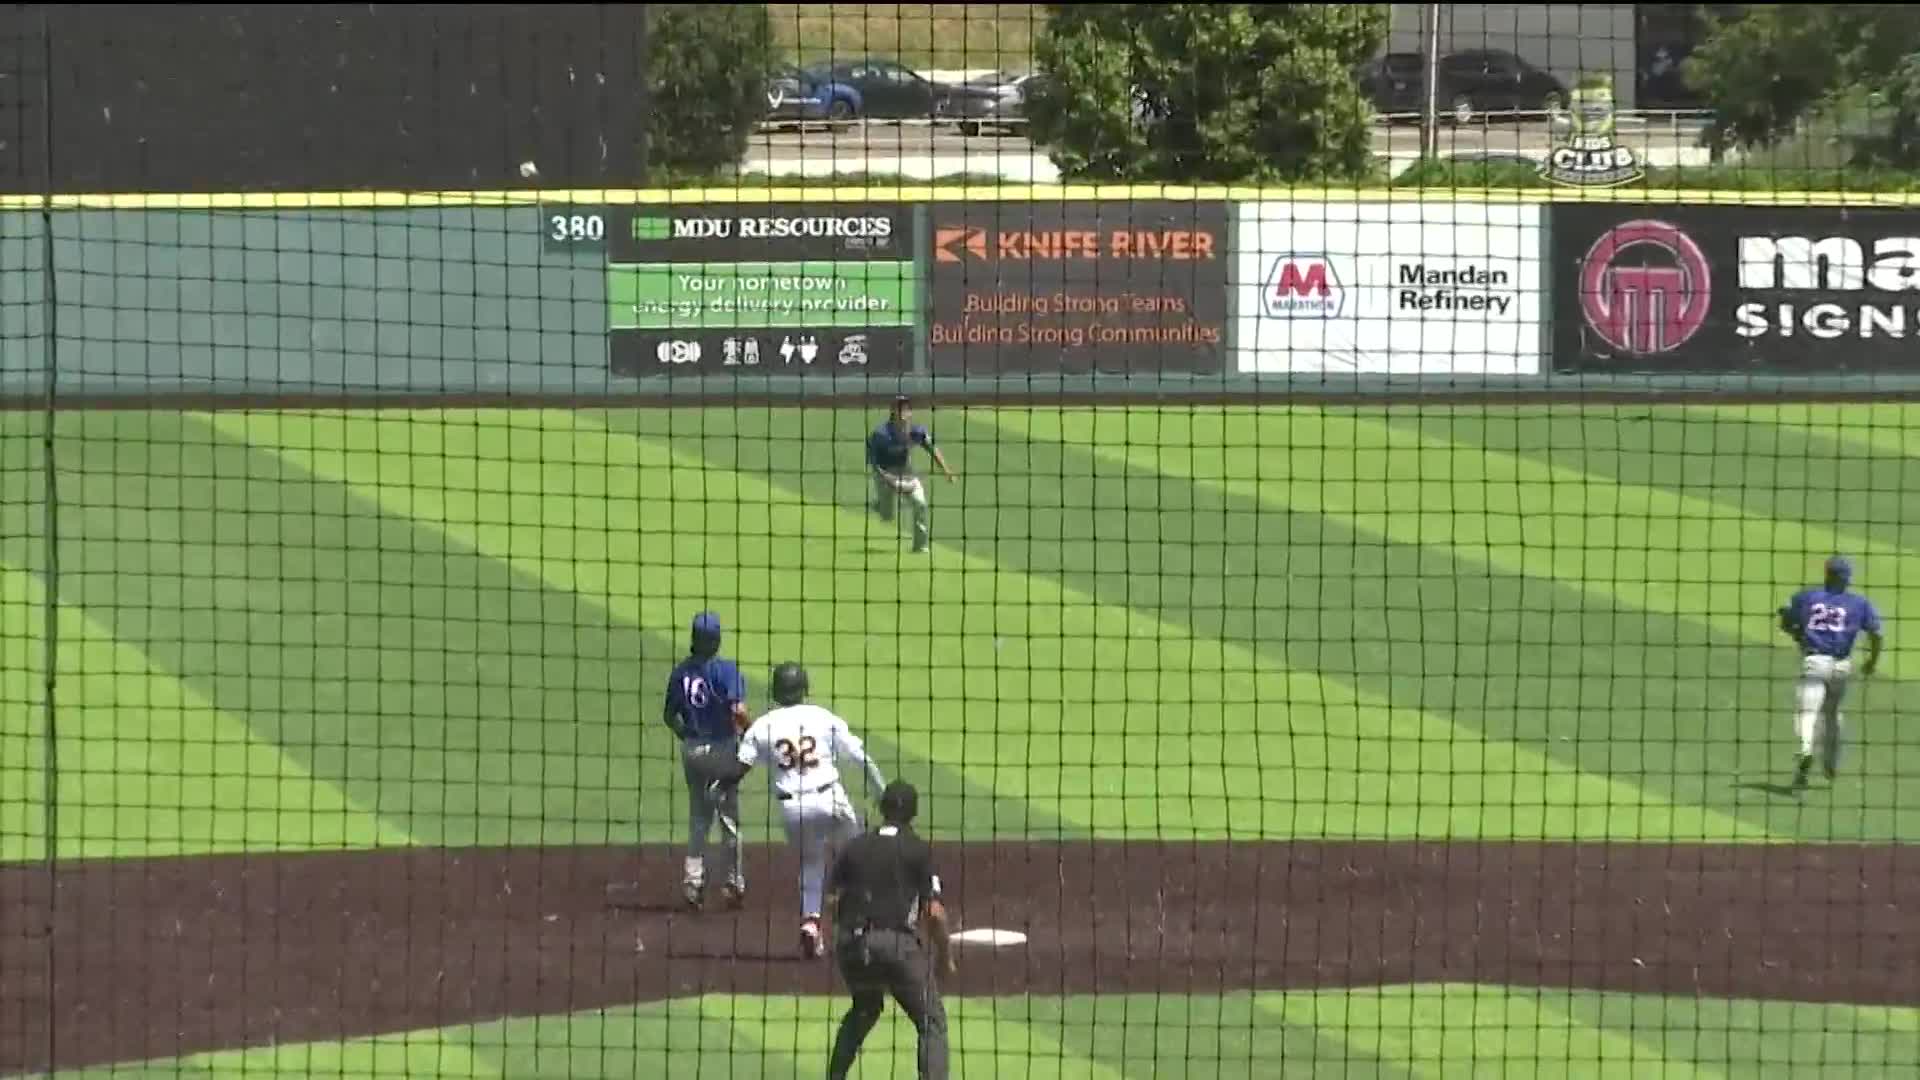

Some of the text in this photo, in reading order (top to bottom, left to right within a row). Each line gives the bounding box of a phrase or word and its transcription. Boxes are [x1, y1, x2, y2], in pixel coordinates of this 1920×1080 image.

[551, 215, 604, 240] 380
[673, 217, 892, 238] MDU RESOURCES
[999, 231, 1215, 259] KNIFE RIVER
[679, 275, 725, 291] Your
[1276, 263, 1331, 296] M
[1399, 265, 1508, 285] Mandan
[967, 295, 1048, 314] Building
[1054, 294, 1119, 313] Strong
[1399, 290, 1511, 315] Refinery
[1735, 303, 1920, 338] SIGN
[931, 324, 1221, 346] Building Strong Communities
[1808, 603, 1847, 632] 23
[775, 735, 819, 771] 32
